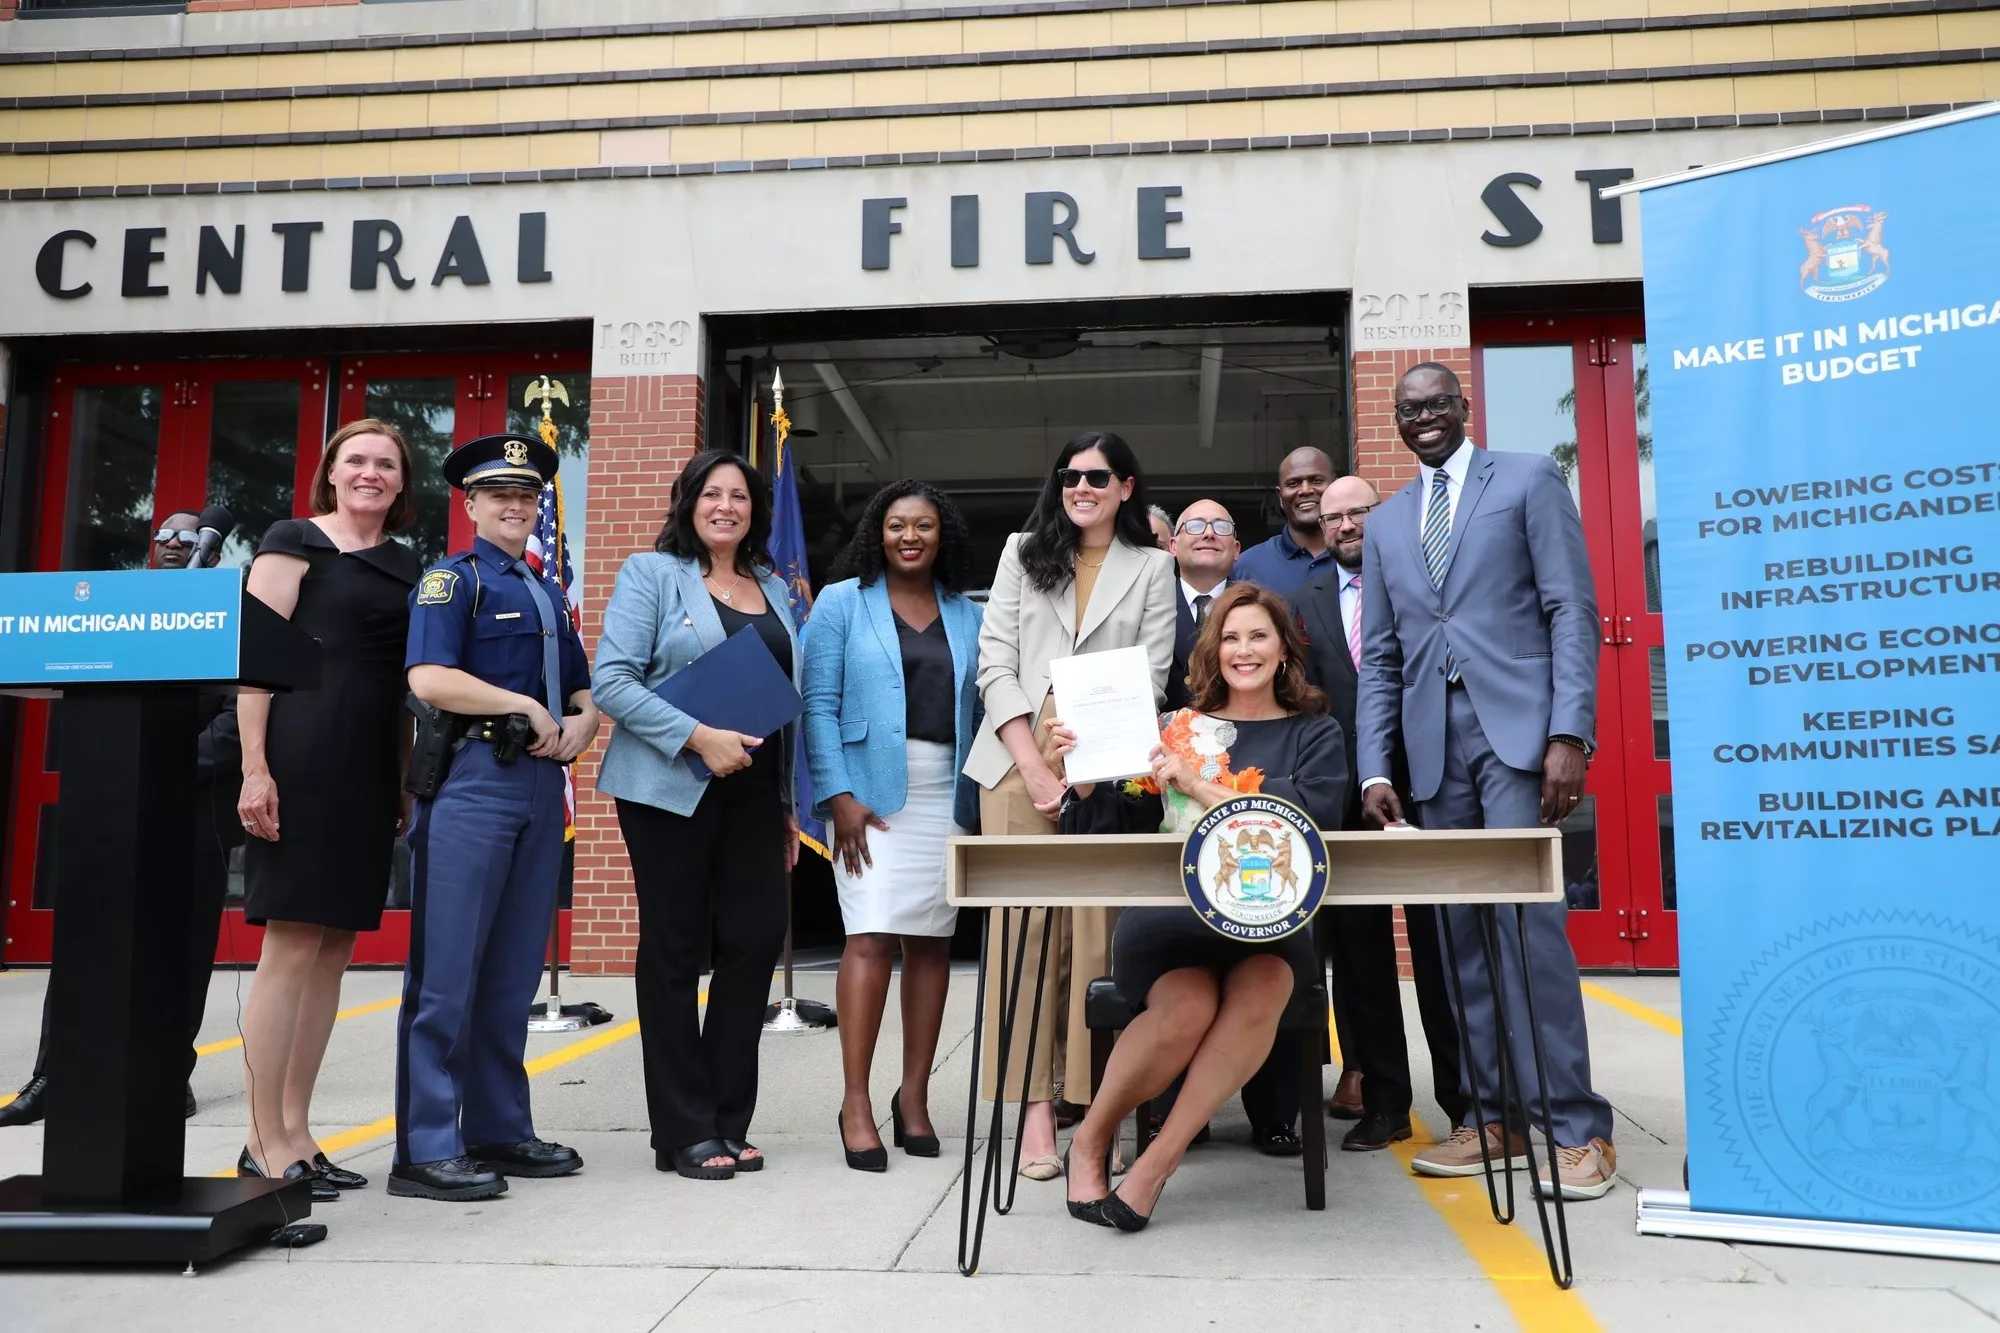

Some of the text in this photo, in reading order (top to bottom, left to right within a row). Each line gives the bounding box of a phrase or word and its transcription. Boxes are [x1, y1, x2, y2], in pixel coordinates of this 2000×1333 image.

[35, 165, 1703, 299] CENTRAL FIRE ST
[1363, 325, 1461, 340] RESTORED
[1673, 338, 1765, 370] MAKE
[1775, 332, 1804, 356] IT
[1813, 325, 1848, 352] IN
[620, 352, 671, 366] BUILT
[1782, 345, 1922, 386] BUDGET
[1715, 462, 2000, 510] LOWERING COST
[1698, 490, 2000, 539] FOR MICHIGANDE
[1764, 545, 1973, 581] REBUILDING
[1721, 571, 2000, 610] INFRASTRUCTUR
[19, 615, 40, 634] IN
[44, 612, 145, 633] MICHIGAN
[150, 611, 227, 631] BUDGET
[1686, 623, 2000, 661] POWERING ECONO
[1803, 706, 1954, 731] KEEPING
[1713, 736, 1956, 763] COMMUNITIES
[1197, 799, 1311, 836] STATE OF MICHIGAN
[1758, 789, 1924, 812] BUILDING
[1701, 817, 1933, 840] REVITALIZING
[1221, 920, 1291, 937] GOVERNOR
[1230, 908, 1283, 919] CIRCUMSPICE
[1825, 949, 1857, 971] OF
[1859, 944, 1915, 962] THE
[1772, 963, 1823, 1008] SEAL
[1745, 1006, 1777, 1082] GREAT
[1746, 1087, 1772, 1134] THE
